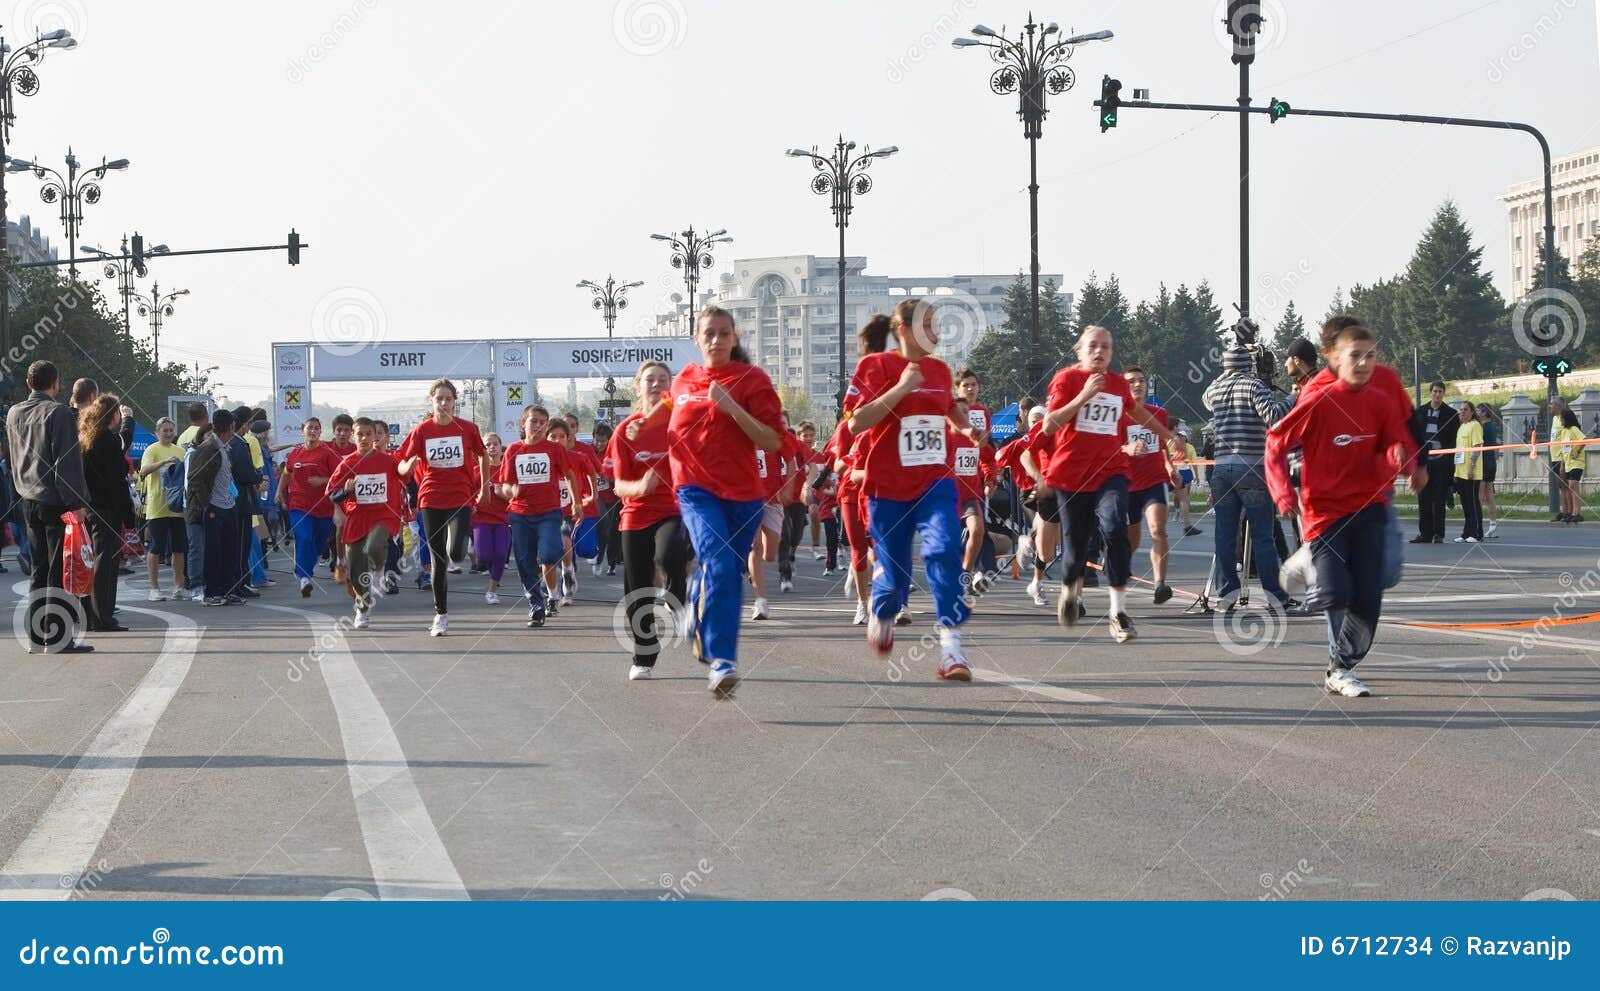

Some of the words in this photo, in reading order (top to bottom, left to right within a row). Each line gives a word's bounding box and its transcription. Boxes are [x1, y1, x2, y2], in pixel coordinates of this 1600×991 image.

[380, 352, 427, 367] START
[572, 348, 673, 363] SOSIRE/FINISH
[1081, 403, 1117, 422] 1371
[430, 446, 461, 460] 2594
[519, 462, 547, 475] 1402
[358, 482, 386, 496] 2525
